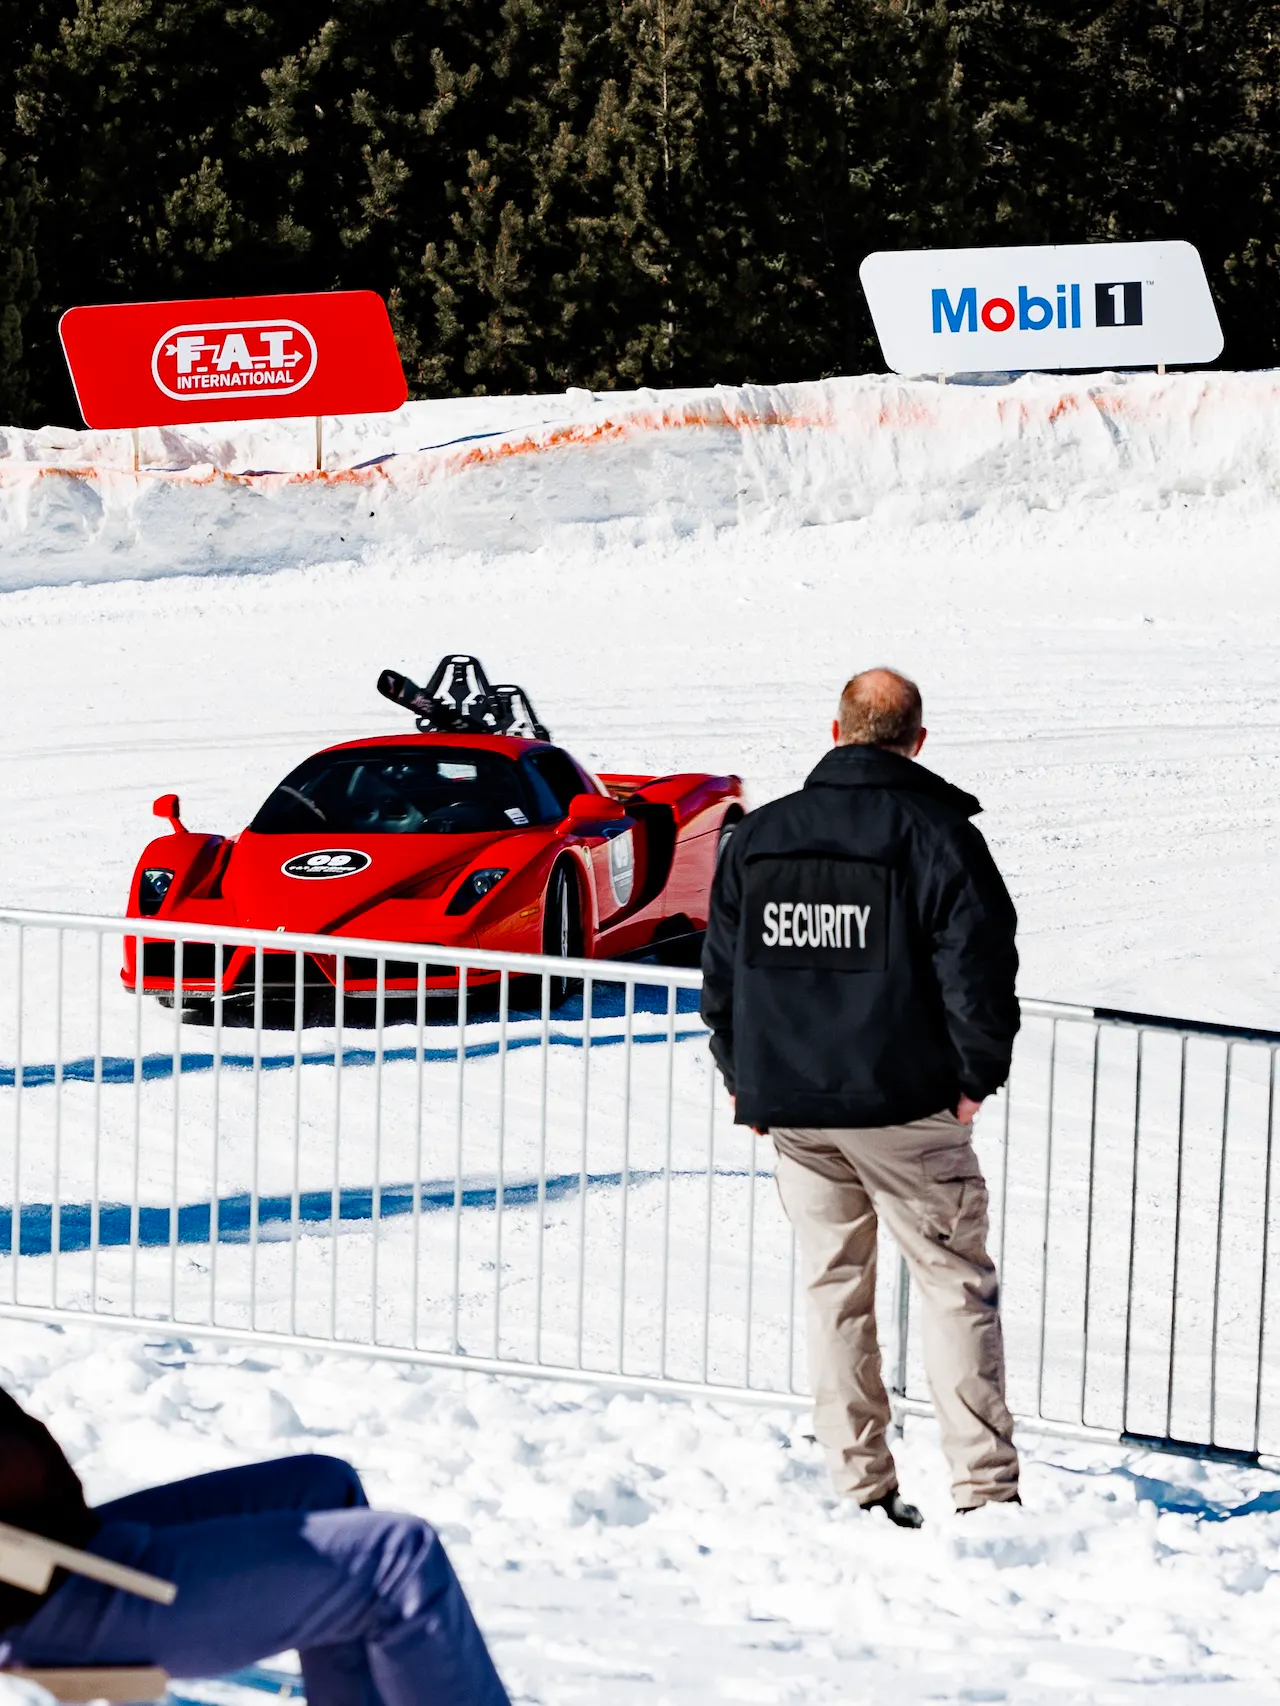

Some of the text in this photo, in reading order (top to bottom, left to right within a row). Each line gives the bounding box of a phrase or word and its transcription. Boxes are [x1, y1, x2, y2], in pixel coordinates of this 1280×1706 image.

[931, 283, 1081, 333] Mobil
[177, 370, 294, 389] INTERNATIONAL
[762, 902, 871, 949] SECURITY
